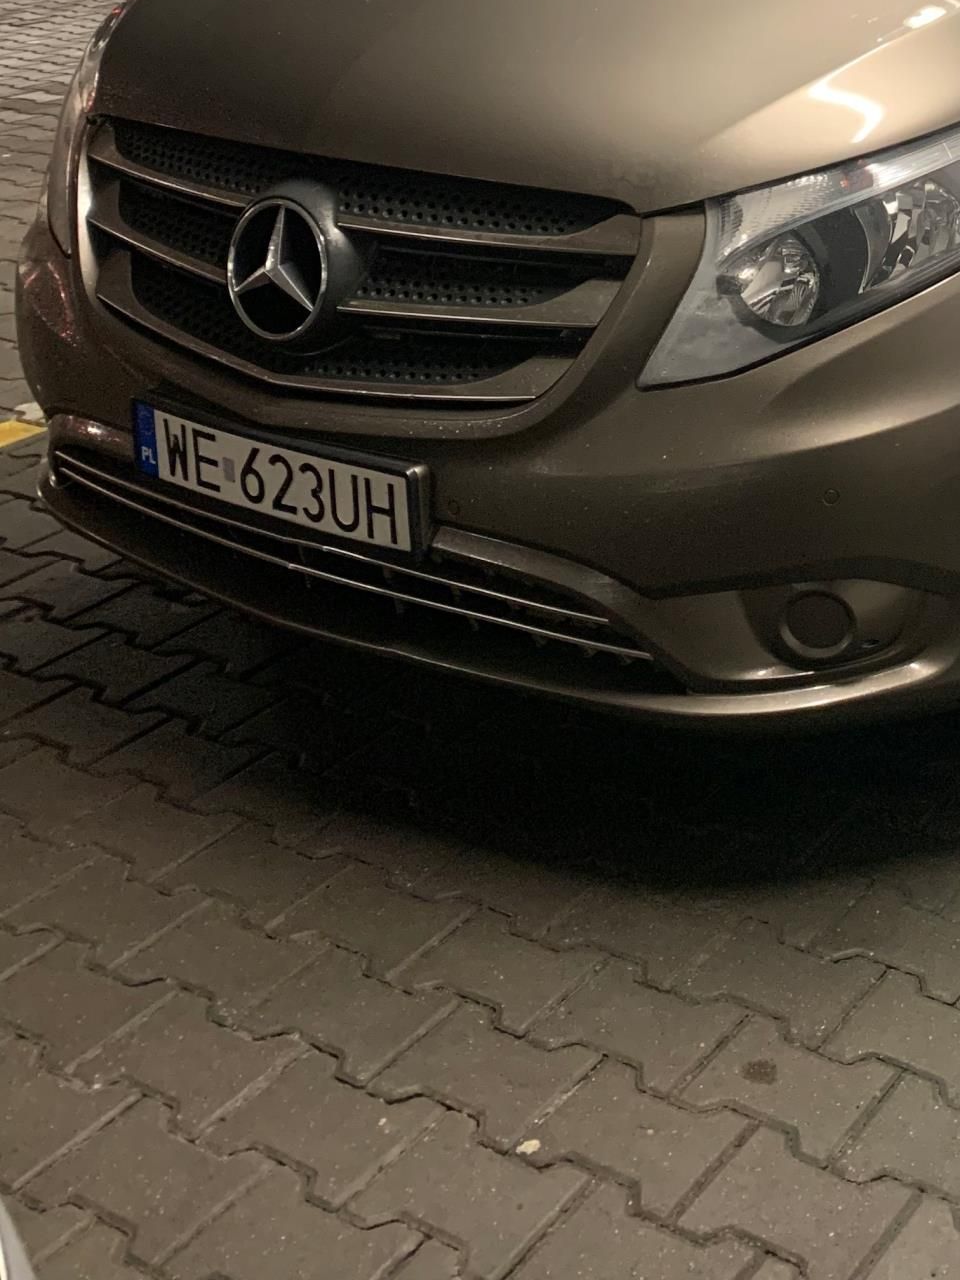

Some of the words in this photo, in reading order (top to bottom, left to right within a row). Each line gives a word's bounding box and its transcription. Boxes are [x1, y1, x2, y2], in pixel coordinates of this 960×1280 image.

[141, 446, 156, 464] PL
[163, 418, 221, 493] WE
[240, 447, 398, 545] 623UH
